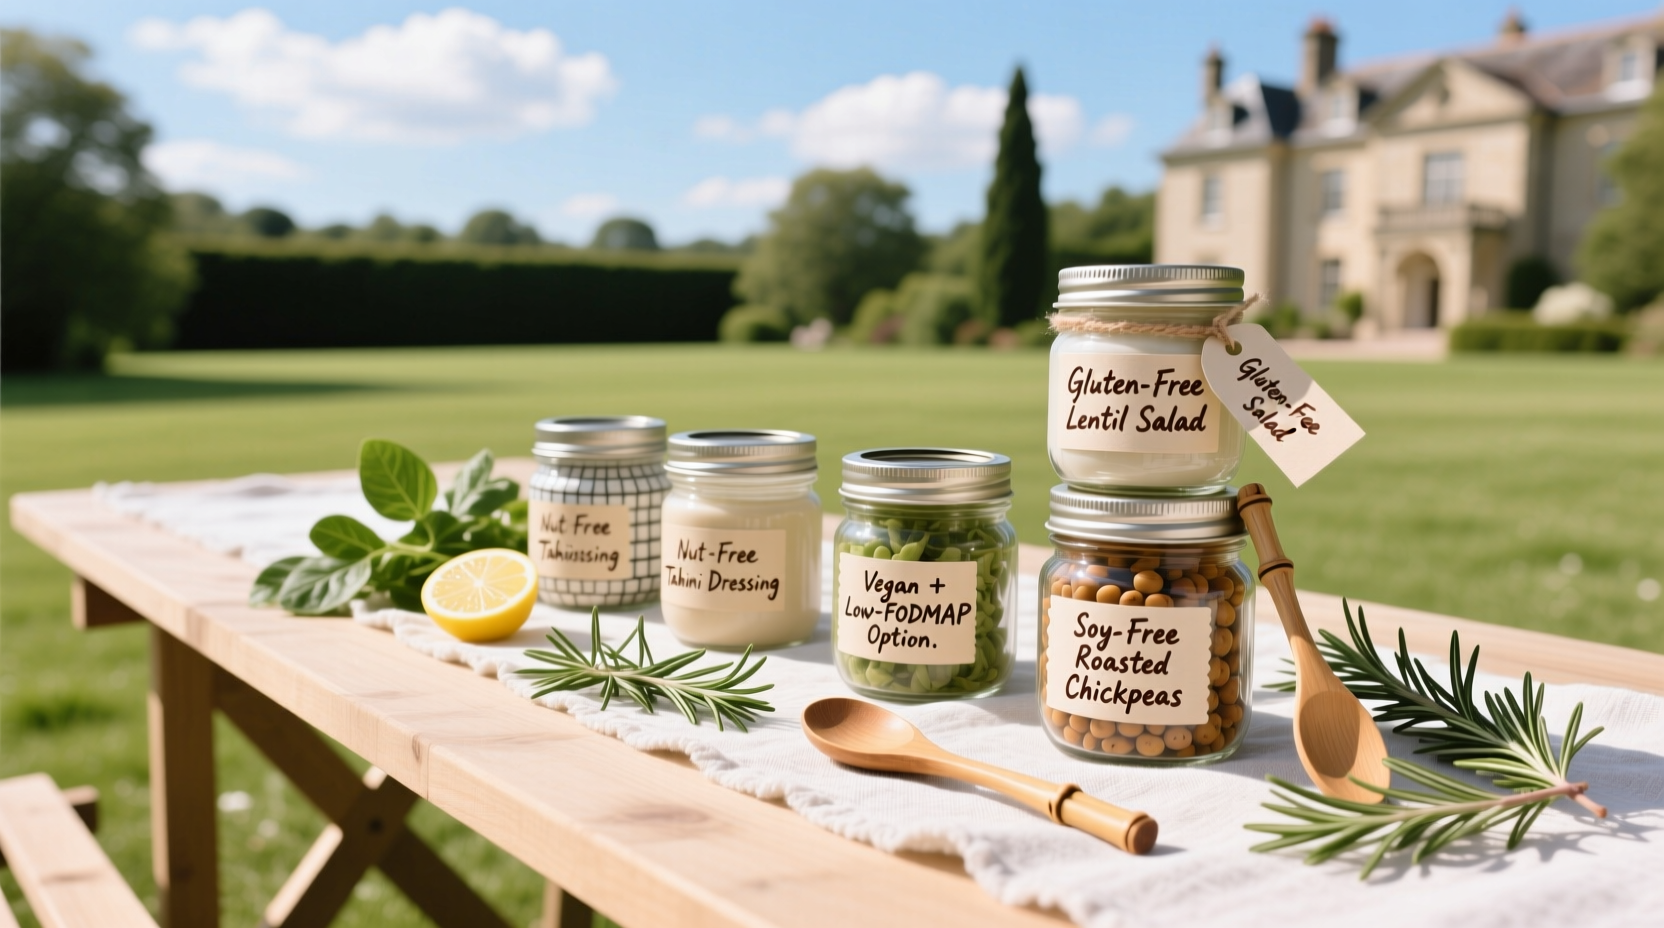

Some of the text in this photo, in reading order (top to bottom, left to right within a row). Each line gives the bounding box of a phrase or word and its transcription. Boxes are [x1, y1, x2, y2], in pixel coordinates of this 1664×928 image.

[1068, 365, 1204, 404] Gluten-Free
[1066, 403, 1208, 433] Lentil Salad
[540, 512, 612, 536] Nut Free
[677, 538, 759, 564] Nut-Free
[665, 565, 780, 601] Tahini Dressing
[864, 569, 946, 604] Vegan +
[845, 595, 972, 626] Low-FODMAP
[867, 623, 938, 655] Option.
[1073, 611, 1180, 652] Soy-Free
[1075, 643, 1172, 676] Roasted
[1065, 673, 1183, 715] Chickpeas
